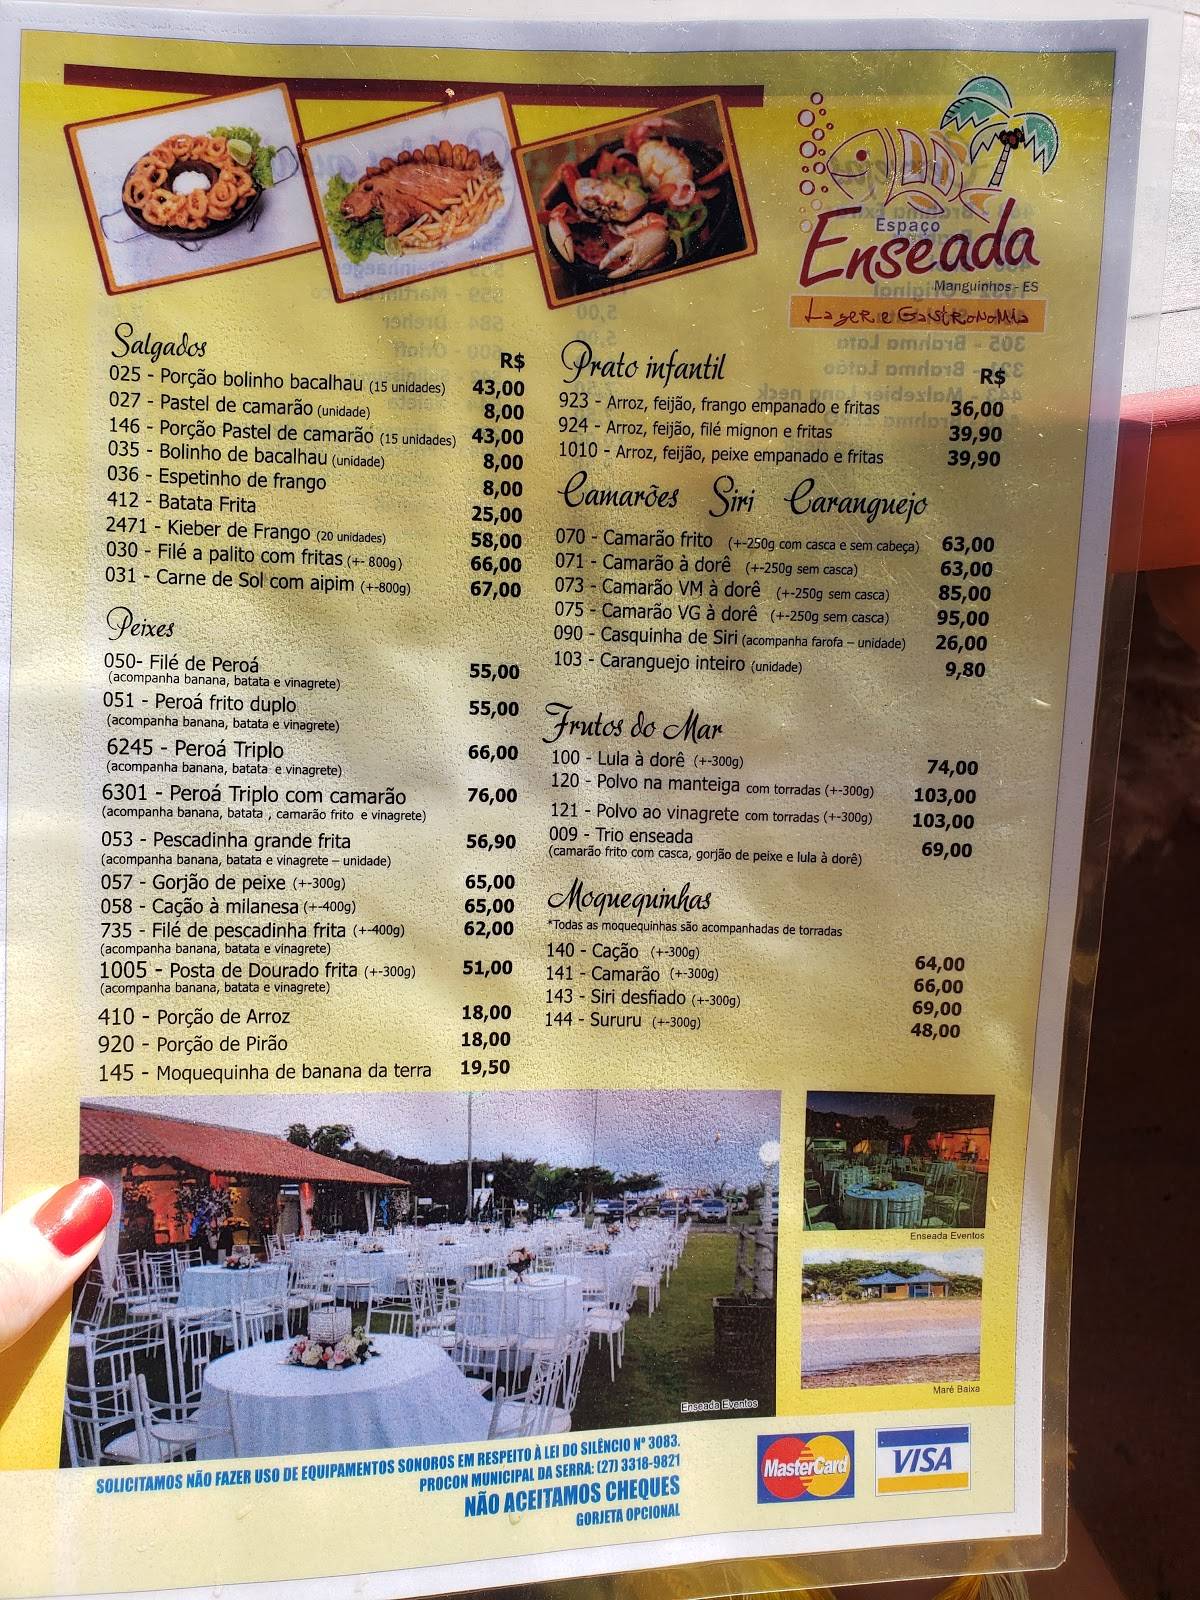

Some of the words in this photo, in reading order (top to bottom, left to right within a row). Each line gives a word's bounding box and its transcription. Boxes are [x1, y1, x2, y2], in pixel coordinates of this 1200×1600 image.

[875, 217, 941, 233] Espaço
[800, 198, 1041, 288] Enseada
[934, 280, 1012, 293] Manguinhos
[1022, 281, 1039, 293] ES
[880, 308, 893, 324] e
[111, 322, 208, 364] Salgados
[500, 351, 526, 373] R$
[560, 339, 639, 384] Prato
[645, 348, 727, 389] infantil
[109, 364, 141, 383] 025
[160, 367, 217, 389] Porção
[223, 370, 284, 389] bolinho
[290, 372, 363, 392] bacalhau
[369, 380, 388, 395] (15
[391, 381, 446, 397] unidades)
[472, 379, 525, 400] 43,00
[980, 367, 1006, 389] R$
[559, 391, 589, 409] 923
[606, 395, 648, 413] Arroz,
[653, 395, 696, 415] feijão,
[700, 396, 747, 416] frango
[751, 398, 826, 417] empanado
[830, 402, 840, 415] e
[844, 399, 880, 416] fritas
[950, 400, 1004, 421] 36,00
[107, 464, 139, 483] 036
[159, 467, 242, 489] Espetinho
[246, 471, 268, 488] de
[273, 472, 327, 494] frango
[482, 479, 523, 500] 8,00
[106, 490, 139, 508] 412
[159, 493, 213, 512] Batata
[219, 495, 257, 514] Frita
[471, 505, 523, 526] 25,00
[556, 470, 680, 509] Camarões
[708, 474, 756, 518] Siri
[783, 477, 929, 525] Caranguejo
[555, 527, 586, 545] 070
[603, 528, 675, 548] Camarão
[680, 530, 713, 549] frito
[778, 540, 802, 550] com
[806, 541, 836, 551] casca
[839, 541, 847, 551] e
[849, 542, 873, 551] sem
[876, 539, 920, 555] cabeça)
[941, 535, 995, 556] 63,00
[105, 566, 136, 583] 031
[156, 568, 207, 586] Carne
[211, 570, 233, 587] de
[238, 571, 264, 589] Sol
[269, 576, 304, 590] com
[310, 574, 355, 595] aipim
[360, 580, 411, 597] (+-800g)
[470, 580, 522, 601] 67,00
[106, 605, 175, 641] Peixes
[108, 670, 180, 686] (acompanha
[184, 673, 230, 688] banana,
[234, 674, 270, 687] batata
[273, 678, 281, 688] e
[284, 678, 341, 692] vinagrete)
[469, 662, 520, 682] 55,00
[150, 653, 179, 671] Filé
[184, 654, 206, 672] de
[212, 655, 259, 674] Peroá
[554, 650, 582, 667] 103
[600, 651, 690, 674] Caranguejo
[695, 655, 746, 672] inteiro
[750, 660, 803, 675] (unidade)
[945, 661, 986, 681] 9,80
[541, 701, 624, 744] Frutos
[630, 710, 657, 738] do
[662, 708, 724, 745] Mar
[552, 749, 580, 765] 100
[598, 750, 629, 767] Lula
[634, 749, 644, 767] à
[649, 751, 685, 768] dorê
[693, 754, 744, 770] (+-300g)
[927, 759, 979, 779] 74,00
[102, 783, 148, 801] 6301
[170, 783, 222, 802] Peroá
[228, 785, 279, 807] Triplo
[285, 790, 323, 804] com
[329, 786, 407, 805] camarão
[467, 787, 518, 806] 76,00
[101, 830, 133, 847] 053
[153, 831, 248, 848] Pescadinha
[254, 832, 313, 852] grande
[318, 832, 351, 849] frita
[466, 833, 517, 852] 56,90
[100, 897, 133, 915] 058
[152, 897, 204, 918] Cação
[209, 896, 220, 915] à
[225, 897, 299, 915] milanesa
[303, 900, 356, 915] (+-400g)
[464, 898, 515, 917] 65,00
[547, 876, 712, 918] Moquequinhas
[547, 942, 575, 958] 140
[591, 942, 639, 962] Cação
[650, 945, 700, 961] (+-300g)
[914, 955, 965, 974] 64,00
[98, 1034, 135, 1054] 920
[157, 1034, 214, 1056] Porção
[219, 1035, 240, 1052] de
[246, 1034, 288, 1052] Pirão
[461, 1031, 511, 1051] 18,00
[99, 1063, 134, 1082] 145
[157, 1063, 269, 1085] Moquequinha
[275, 1063, 296, 1080] de
[302, 1063, 362, 1079] banana
[368, 1062, 388, 1079] da
[393, 1063, 432, 1078] terra
[460, 1059, 511, 1078] 19,50
[910, 1231, 948, 1241] Enseada
[950, 1231, 985, 1240] Eventos
[932, 1384, 955, 1395] Maré
[957, 1384, 981, 1393] Baixa
[681, 1400, 720, 1413] Enseada
[721, 1399, 758, 1410] Eventos
[96, 1473, 184, 1494] SOLICITAMOS
[186, 1469, 212, 1489] NÃO
[215, 1469, 252, 1487] FAZER
[254, 1467, 280, 1484] USO
[282, 1466, 299, 1482] DE
[301, 1459, 395, 1482] EQUIPAMENTOS
[397, 1454, 455, 1474] SONOROS
[457, 1452, 475, 1468] EM
[477, 1447, 532, 1467] RESPEITO
[533, 1443, 542, 1461] À
[544, 1444, 560, 1460] LEI
[562, 1442, 578, 1458] DO
[580, 1437, 631, 1456] SILÊNCIO
[648, 1433, 681, 1450] 3083.
[419, 1473, 469, 1493] PROCON
[471, 1467, 535, 1488] MUNICIPAL
[537, 1465, 553, 1481] DA
[555, 1461, 595, 1479] SERRA:
[596, 1458, 619, 1474] (27)
[620, 1453, 680, 1472] 3318-9821
[763, 1455, 848, 1478] MasterCard
[892, 1446, 952, 1473] VISA
[464, 1490, 500, 1518] NÃO
[503, 1482, 601, 1512] ACEITAMOS
[605, 1474, 680, 1502] CHEQUES
[576, 1508, 624, 1527] GORJETA
[625, 1502, 681, 1522] OPCIONAL
